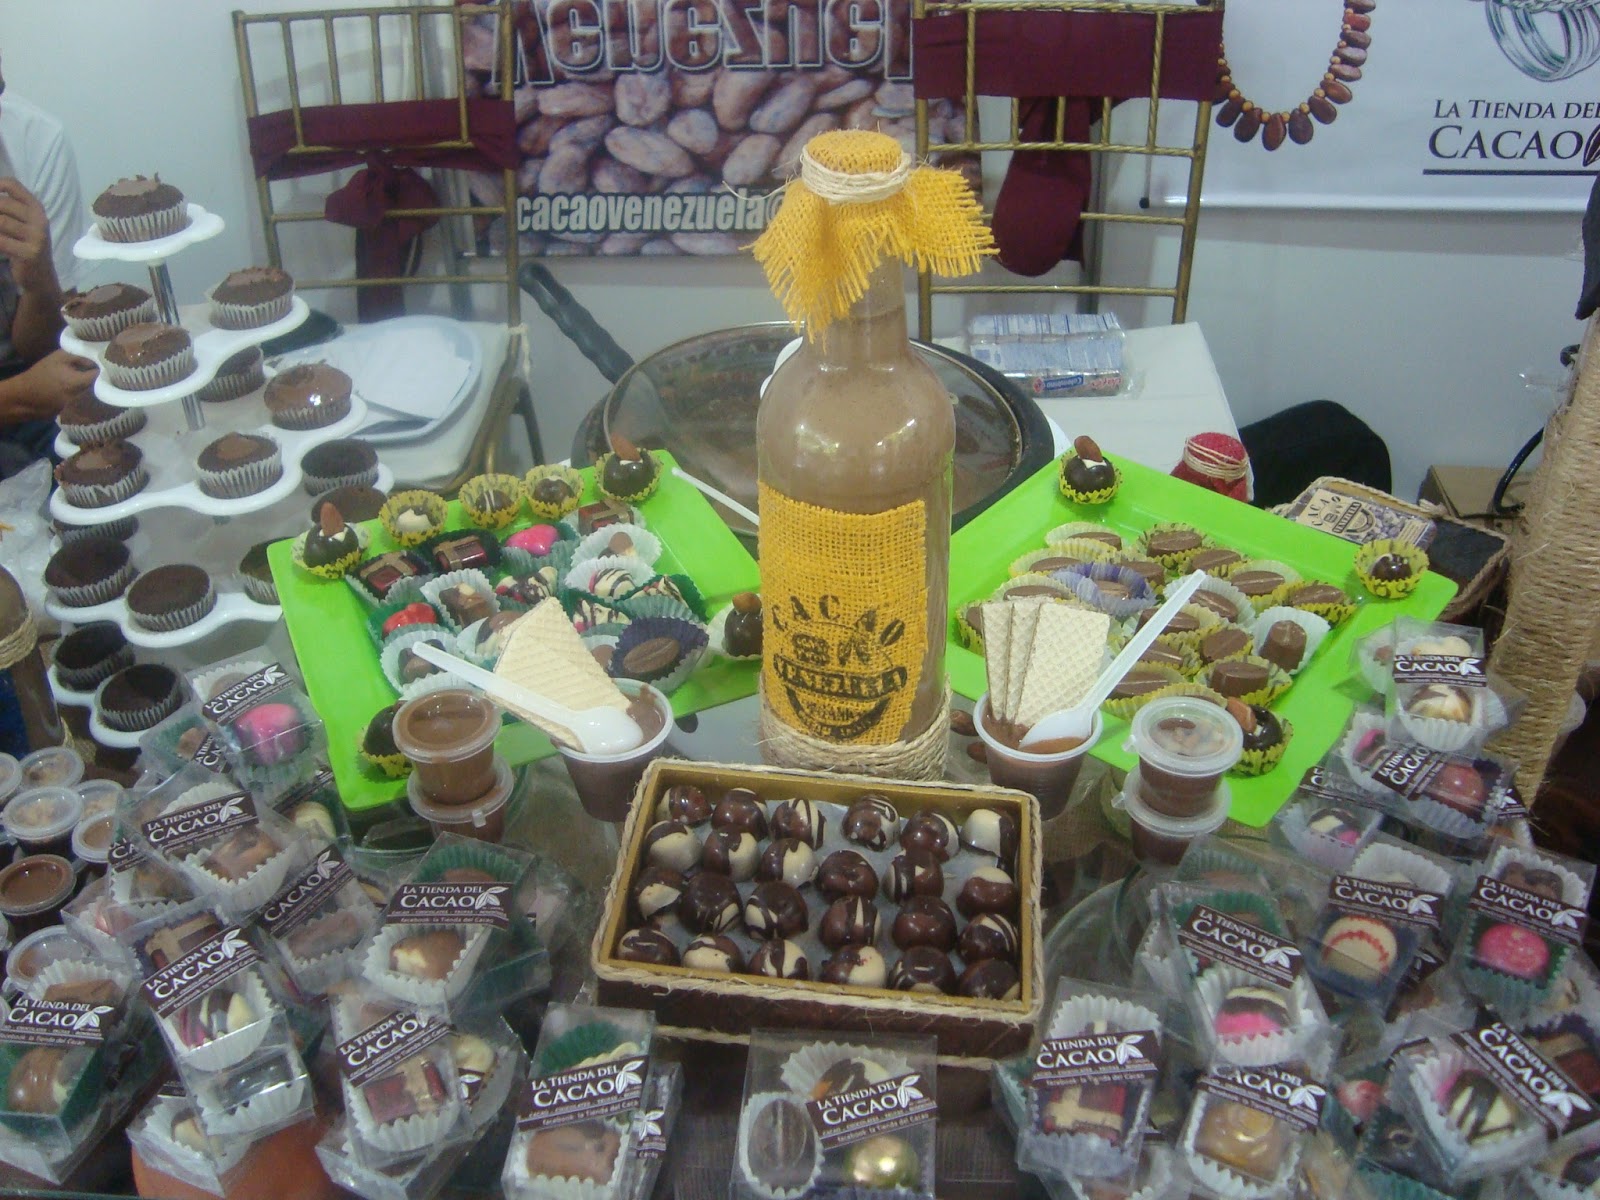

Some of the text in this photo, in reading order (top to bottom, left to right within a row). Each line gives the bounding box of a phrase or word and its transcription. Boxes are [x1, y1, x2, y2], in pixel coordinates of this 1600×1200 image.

[1434, 99, 1460, 118] LA
[1468, 99, 1556, 118] TIENDA
[1428, 124, 1584, 160] CACAO
[1395, 661, 1460, 673] CACAO
[205, 672, 264, 709] LA TIENDA DEL
[213, 680, 267, 714] CACAO
[1378, 767, 1388, 777] LA
[1389, 746, 1431, 785] CACAO
[148, 802, 223, 831] LA TIENDA DEL
[150, 812, 218, 843] CACAO
[264, 874, 322, 921] CACAO
[400, 895, 474, 908] CACAO
[403, 886, 416, 894] LA
[420, 886, 461, 894] TIENDA
[1335, 885, 1408, 910] CACAO
[1336, 876, 1415, 898] LA TIENDA DEL
[1482, 878, 1496, 888] LA
[1499, 883, 1540, 903] TIENDA
[1479, 887, 1553, 920] CACAO
[1192, 919, 1267, 958] CACAO
[1199, 909, 1279, 948] LA TIENDA DEL
[146, 939, 222, 991] LA TIENDA DEL
[154, 951, 224, 998] CACAO
[8, 1008, 78, 1027] CACAO
[16, 998, 91, 1012] LA TIENDA DEL
[339, 1020, 396, 1055] LA TIENDA
[347, 1019, 418, 1066] CACAO
[1050, 1038, 1097, 1051] TIENDA
[1036, 1048, 1116, 1069] CACAO
[1479, 1028, 1551, 1095] CACAO
[1491, 1022, 1568, 1090] LA TIENDA DEL
[531, 1065, 619, 1091] LA TIENDA DEL
[533, 1079, 614, 1108] CACAO
[1214, 1066, 1291, 1099] CACAO
[817, 1080, 898, 1110] LA TIENDA DEL
[822, 1094, 898, 1125] CACAO
